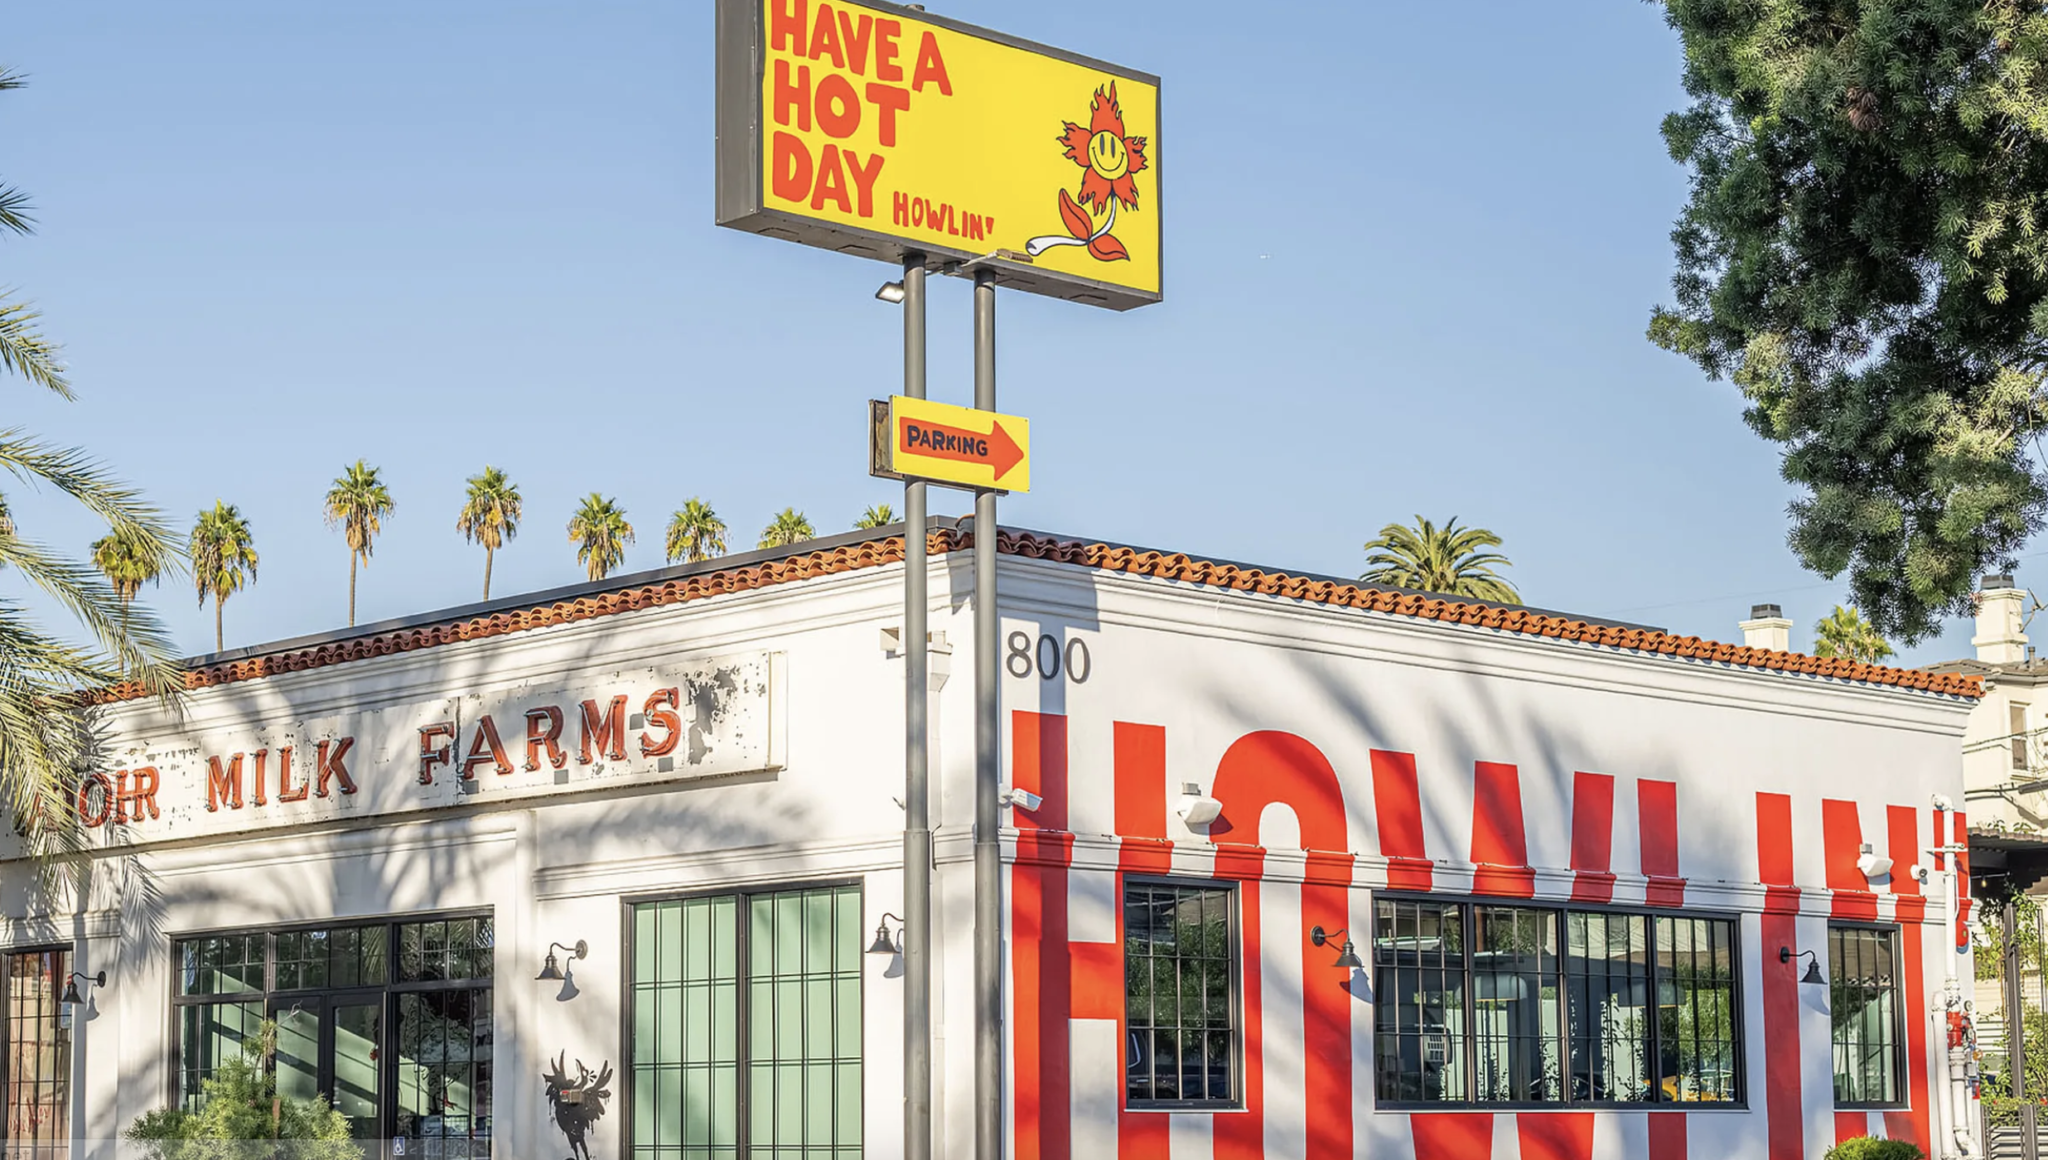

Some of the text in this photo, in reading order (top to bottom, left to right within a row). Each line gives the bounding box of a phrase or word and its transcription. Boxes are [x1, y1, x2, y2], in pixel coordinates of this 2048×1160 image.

[770, 0, 953, 97] HAVE A
[773, 59, 910, 148] HOT
[772, 131, 885, 218] DAY
[907, 425, 988, 457] PARKING
[1006, 631, 1091, 684] 800
[27, 686, 682, 833] OHR MILK FARMS
